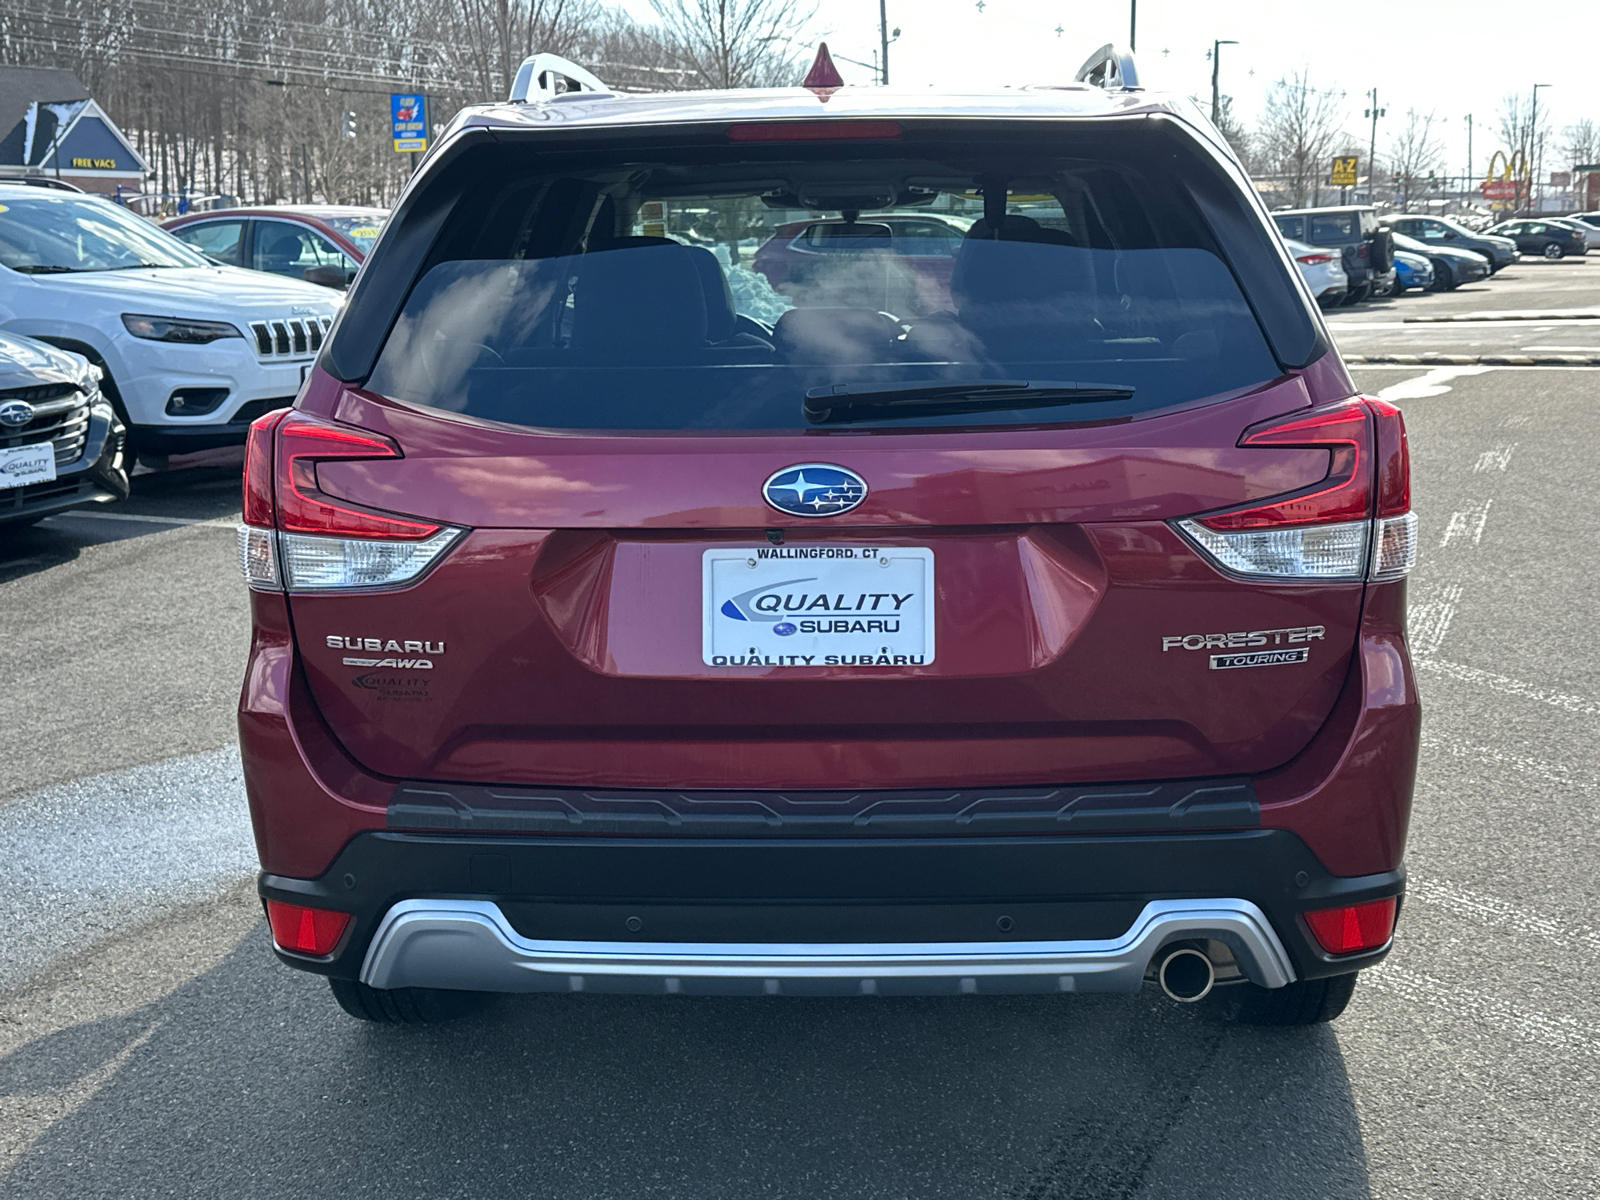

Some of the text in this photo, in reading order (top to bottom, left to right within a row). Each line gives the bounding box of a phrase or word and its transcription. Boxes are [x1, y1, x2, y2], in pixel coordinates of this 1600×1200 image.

[72, 157, 116, 169] FREE VACS
[8, 458, 49, 470] QUALITY
[757, 548, 879, 559] WALLINGFORD, CT
[755, 593, 914, 612] QUALITY
[800, 620, 900, 633] SUBARU
[1161, 625, 1326, 652] FORESTER
[326, 635, 445, 655] SUBARU
[375, 658, 434, 669] AWD
[712, 655, 924, 666] QUALITY SUBARU
[1223, 652, 1299, 666] TOURING
[365, 677, 430, 687] QUALITY
